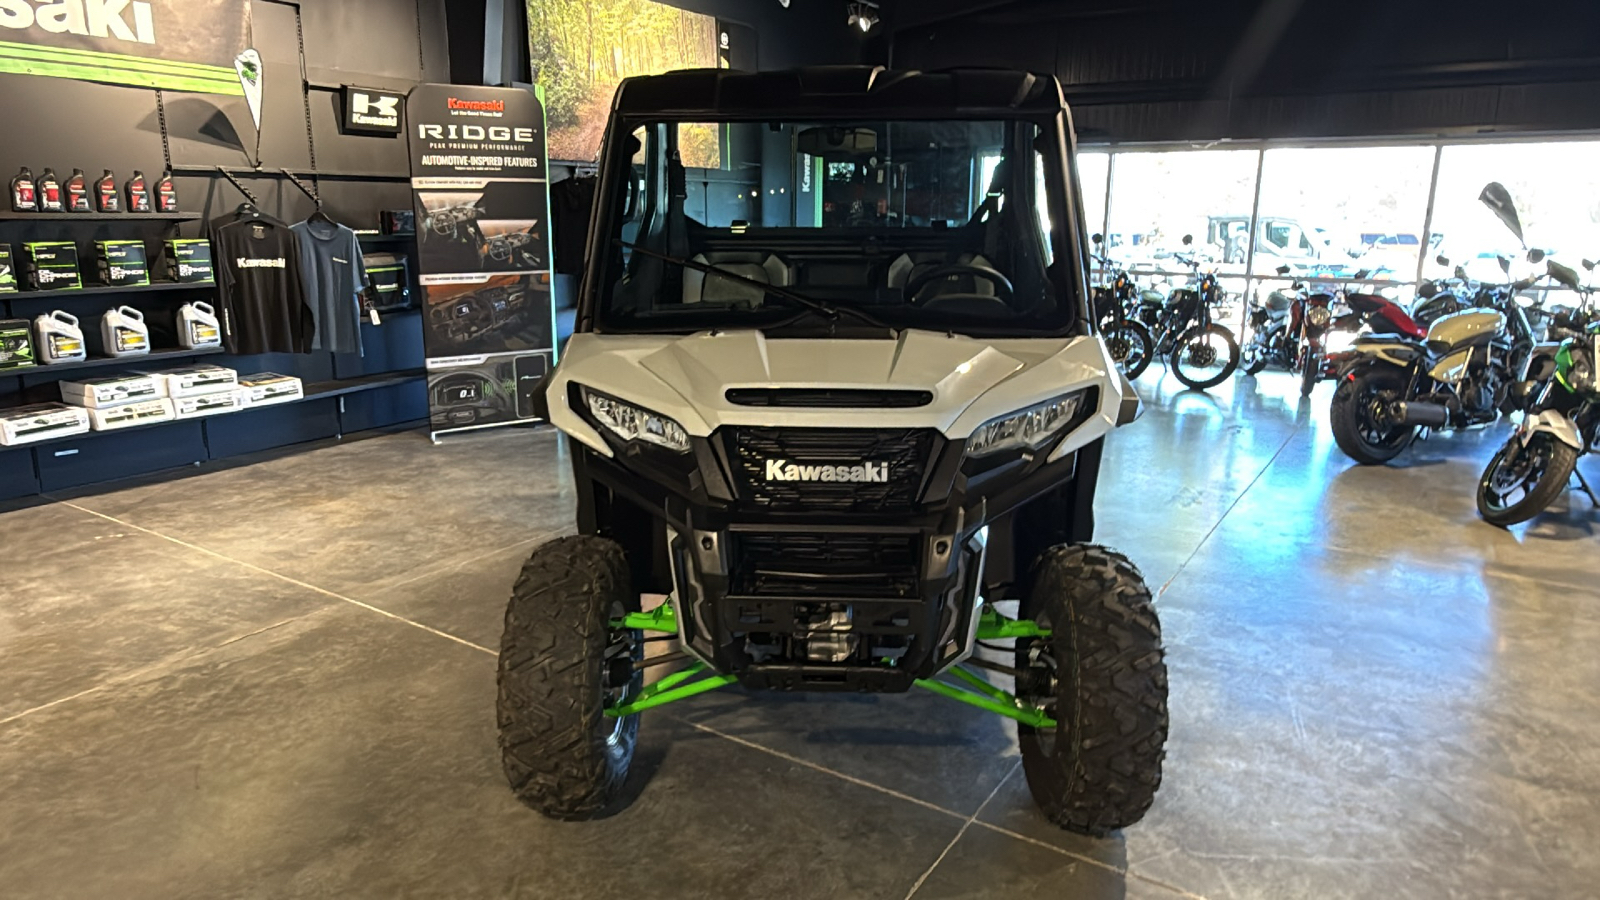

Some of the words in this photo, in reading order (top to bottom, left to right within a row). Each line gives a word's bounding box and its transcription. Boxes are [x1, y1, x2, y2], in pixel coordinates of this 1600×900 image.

[447, 97, 505, 111] Kawasaki
[418, 124, 534, 142] RIDGE
[481, 143, 525, 151] PERFORMANCE
[421, 155, 503, 167] AUTOMOTIVE-INSPIRED
[504, 157, 538, 168] FEATURES
[236, 257, 286, 268] Kawasaki
[766, 459, 889, 483] Kawasaki
